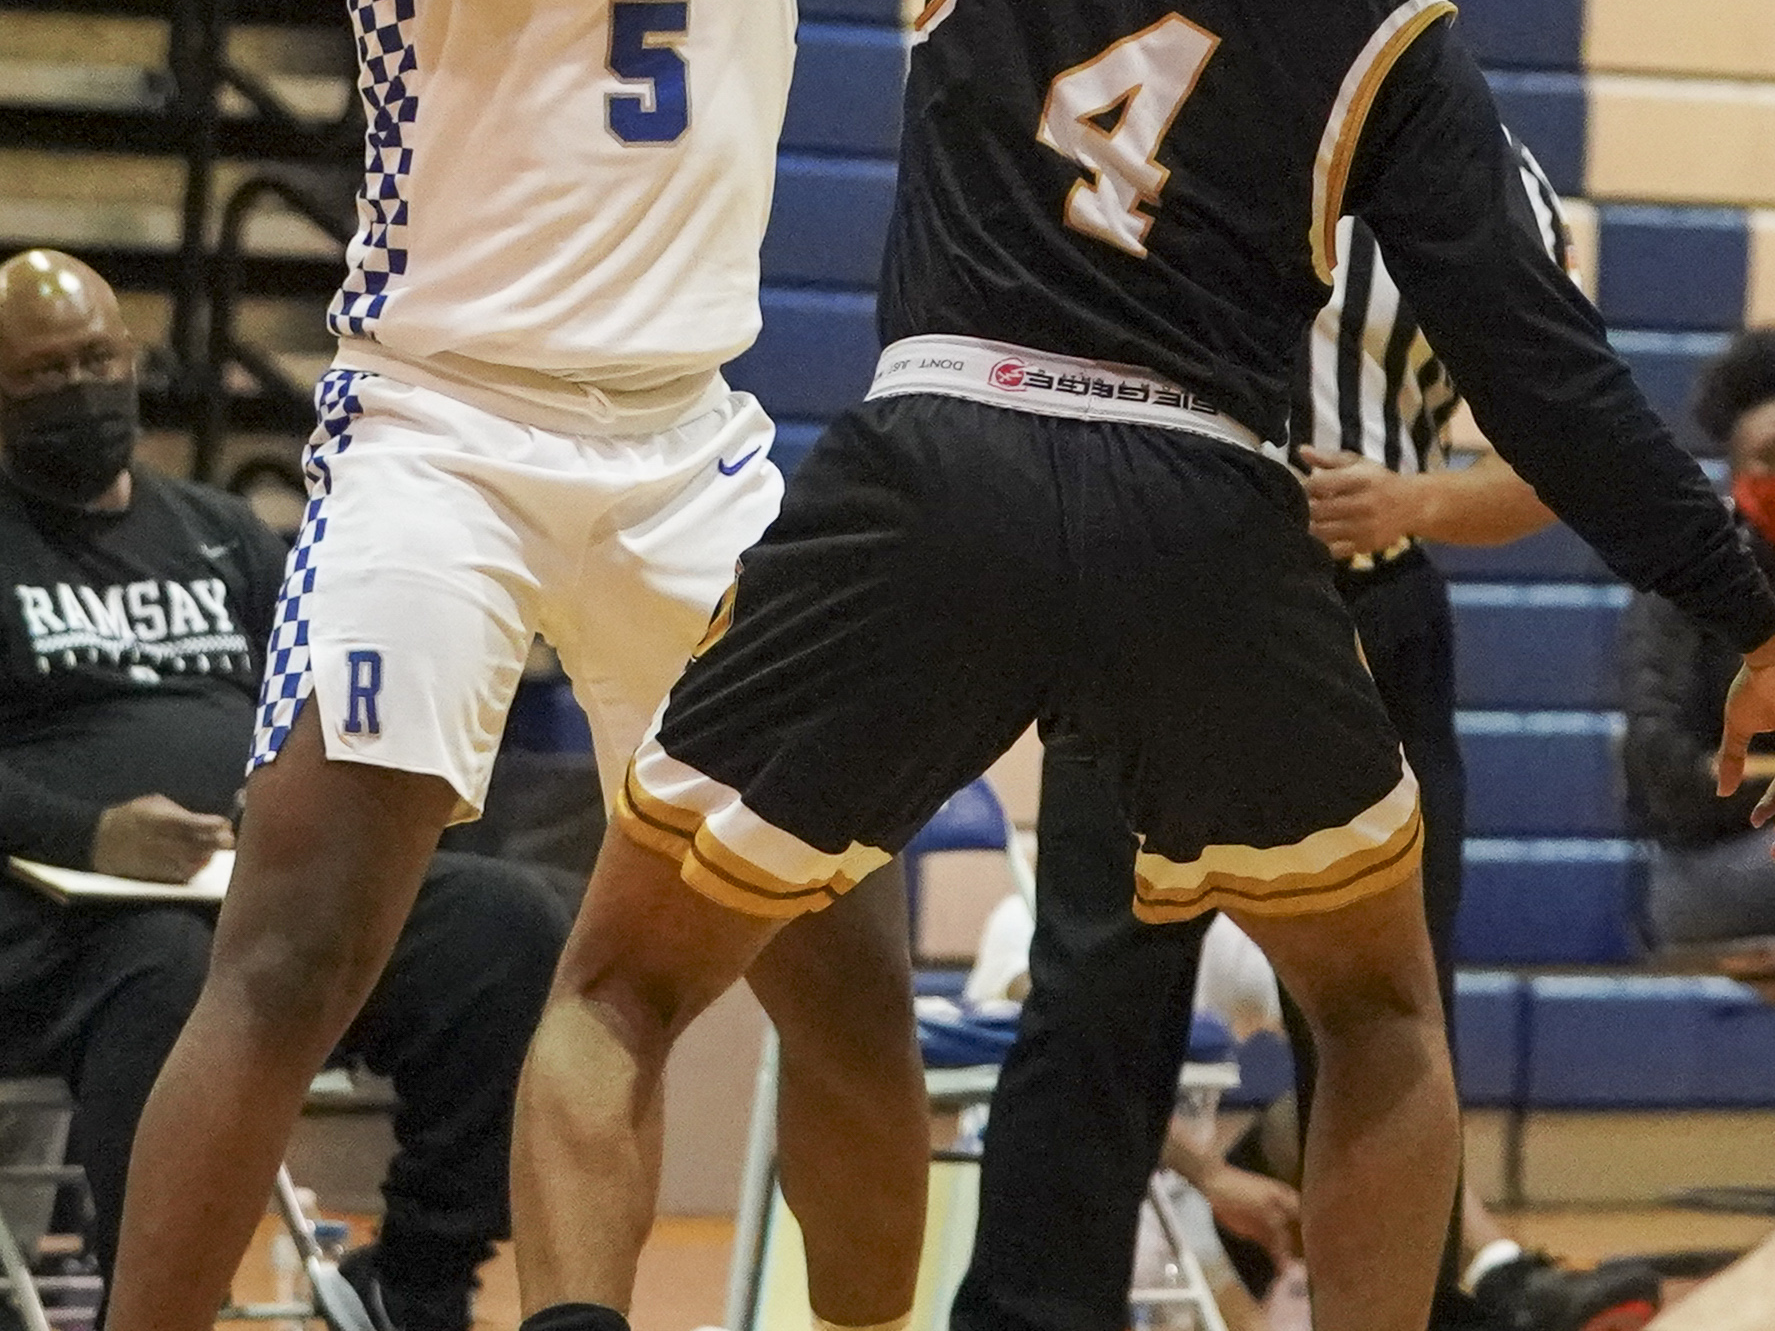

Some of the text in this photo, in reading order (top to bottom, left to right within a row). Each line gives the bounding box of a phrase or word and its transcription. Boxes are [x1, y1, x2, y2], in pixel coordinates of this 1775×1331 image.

[1035, 11, 1222, 259] 4
[14, 578, 235, 642] RAMSAY
[343, 649, 384, 735] R
